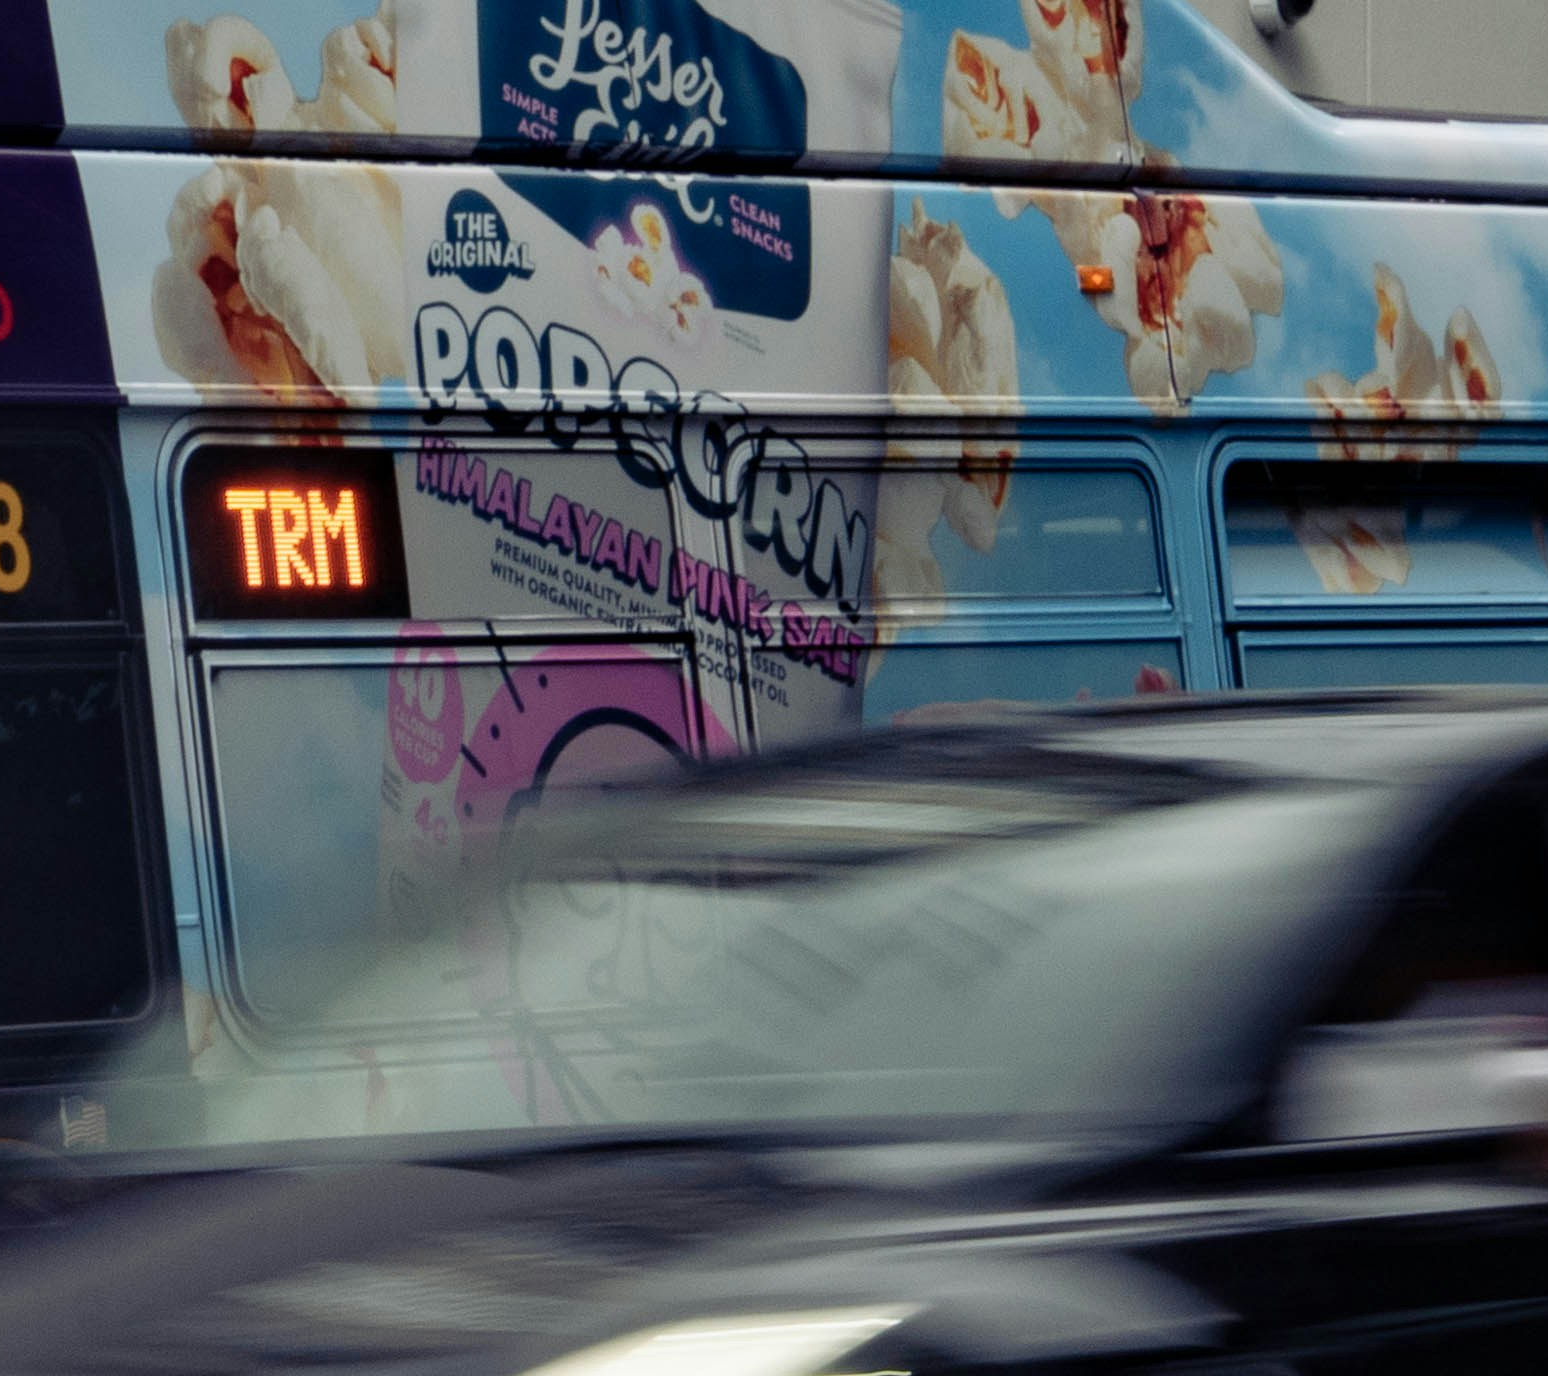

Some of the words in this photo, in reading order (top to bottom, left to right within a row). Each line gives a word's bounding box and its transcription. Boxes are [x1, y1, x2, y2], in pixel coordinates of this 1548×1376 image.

[502, 83, 559, 125] SIMPLE
[452, 212, 499, 238] THE
[729, 194, 781, 232] CLEAN
[428, 239, 536, 280] ORIGINAL
[731, 218, 793, 263] SNACKS
[414, 301, 869, 622] POPCORN
[223, 487, 369, 589] TRM
[416, 435, 663, 594] HIMALAYAN
[667, 548, 775, 642] PINK
[781, 600, 866, 687] SALT
[495, 538, 559, 581] PREMIUM
[563, 570, 626, 614] QUALITY,
[490, 559, 525, 590] WITH
[528, 577, 594, 618] ORGANIC
[767, 683, 790, 708] OIL
